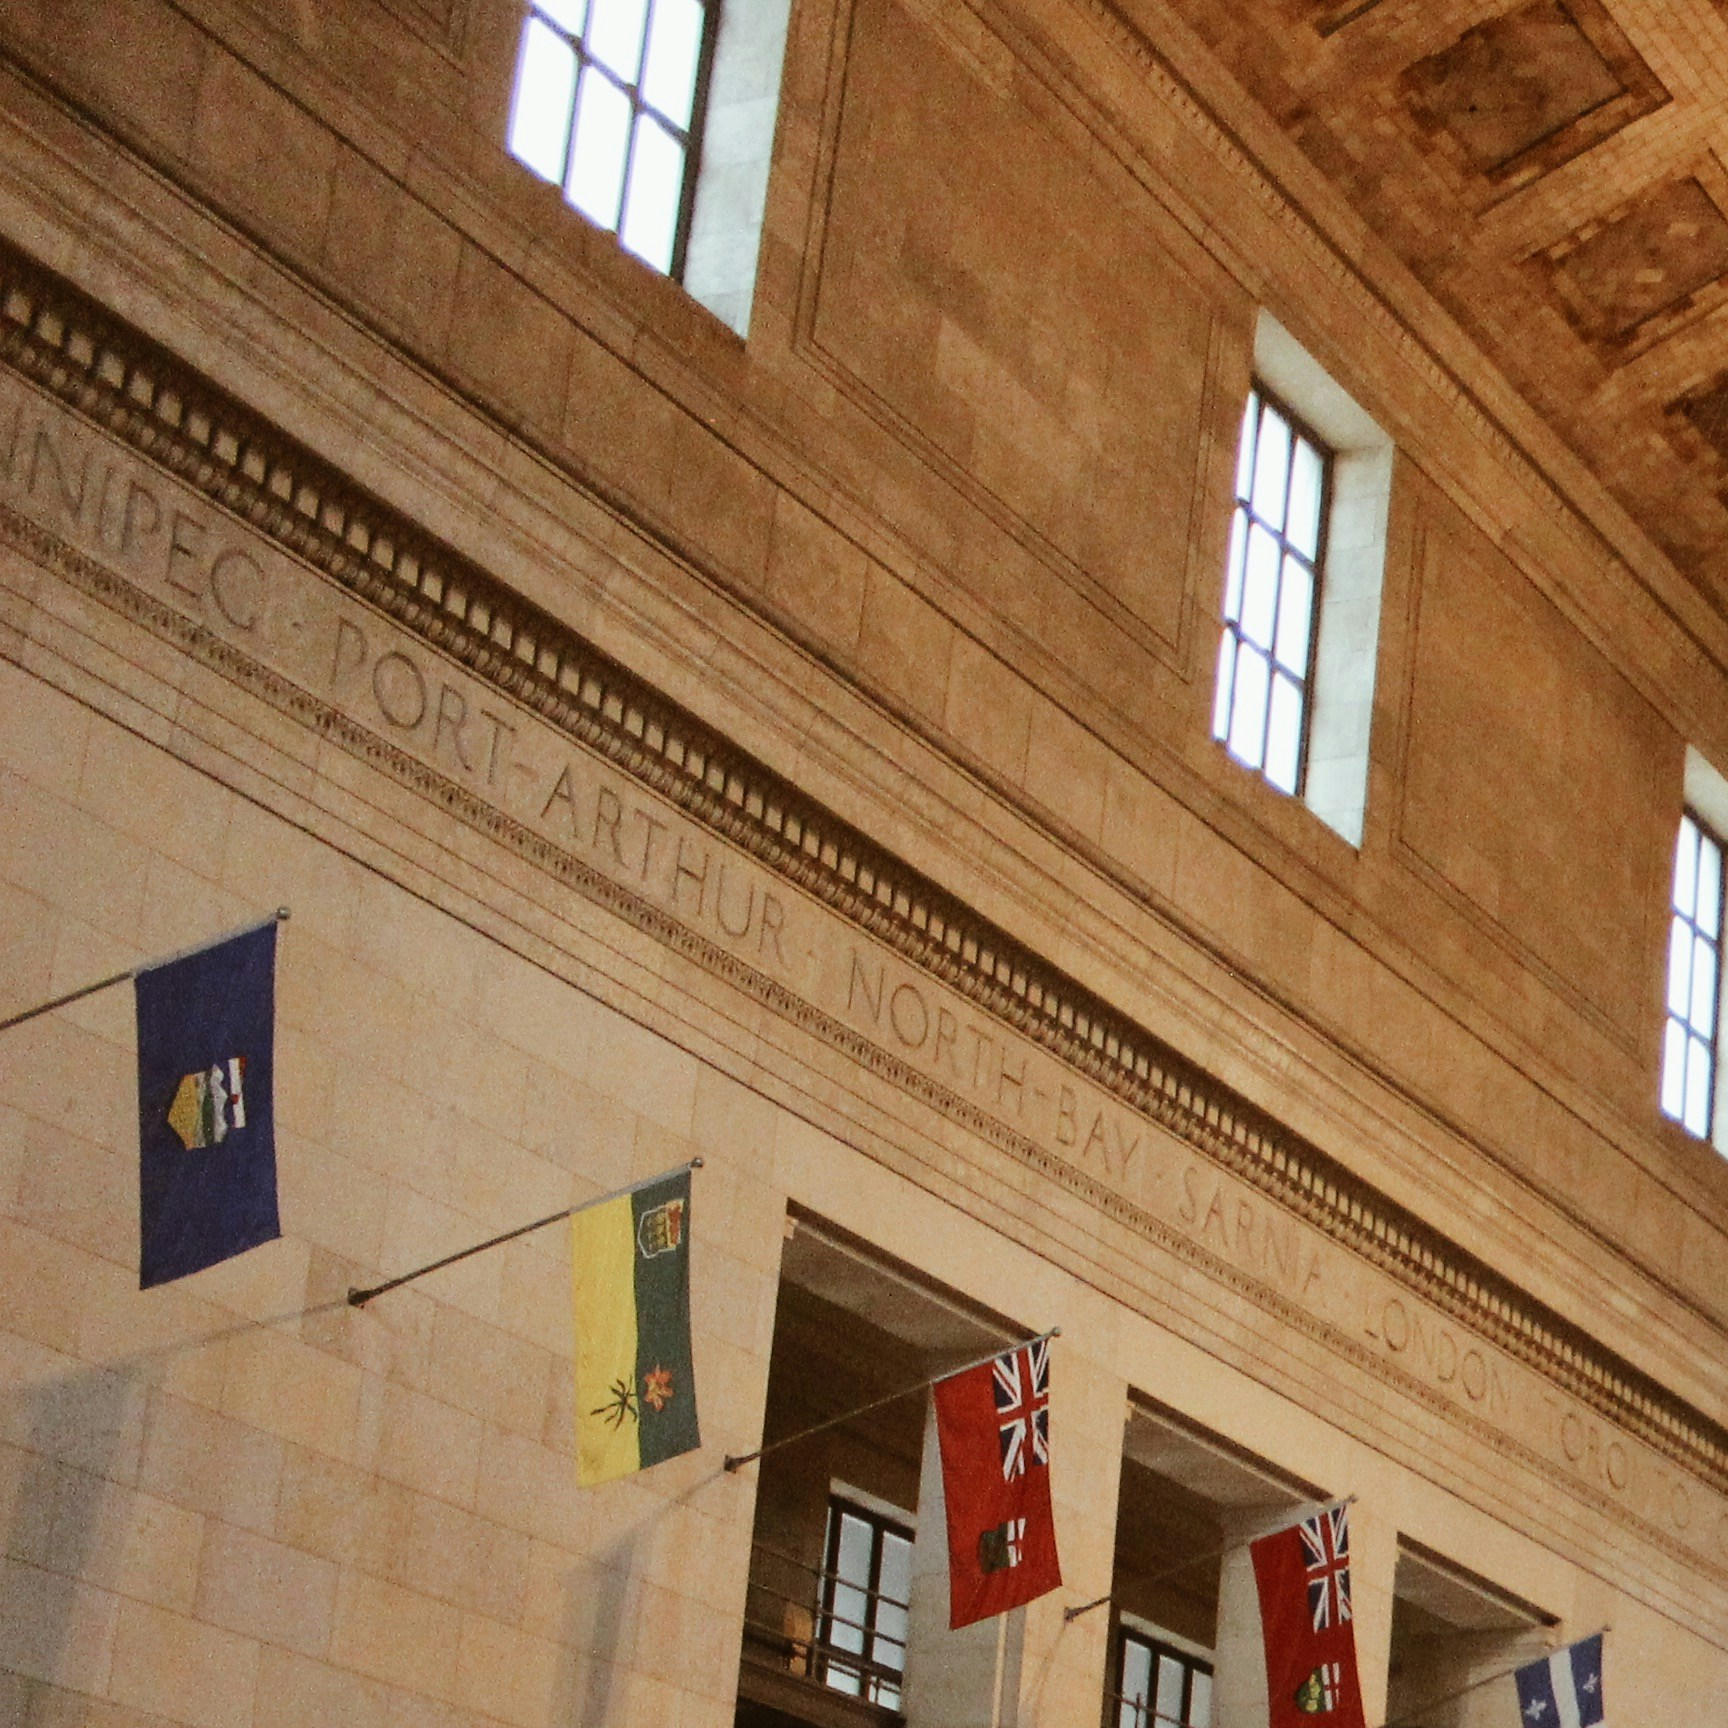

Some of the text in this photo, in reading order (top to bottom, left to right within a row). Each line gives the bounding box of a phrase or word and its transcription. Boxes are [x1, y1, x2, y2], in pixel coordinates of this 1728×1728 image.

[329, 613, 790, 968] PORT-ARTHUR
[846, 947, 1144, 1183] NORTH-BAY
[1178, 1165, 1324, 1294] SARNIA
[1363, 1299, 1511, 1415] LONDON
